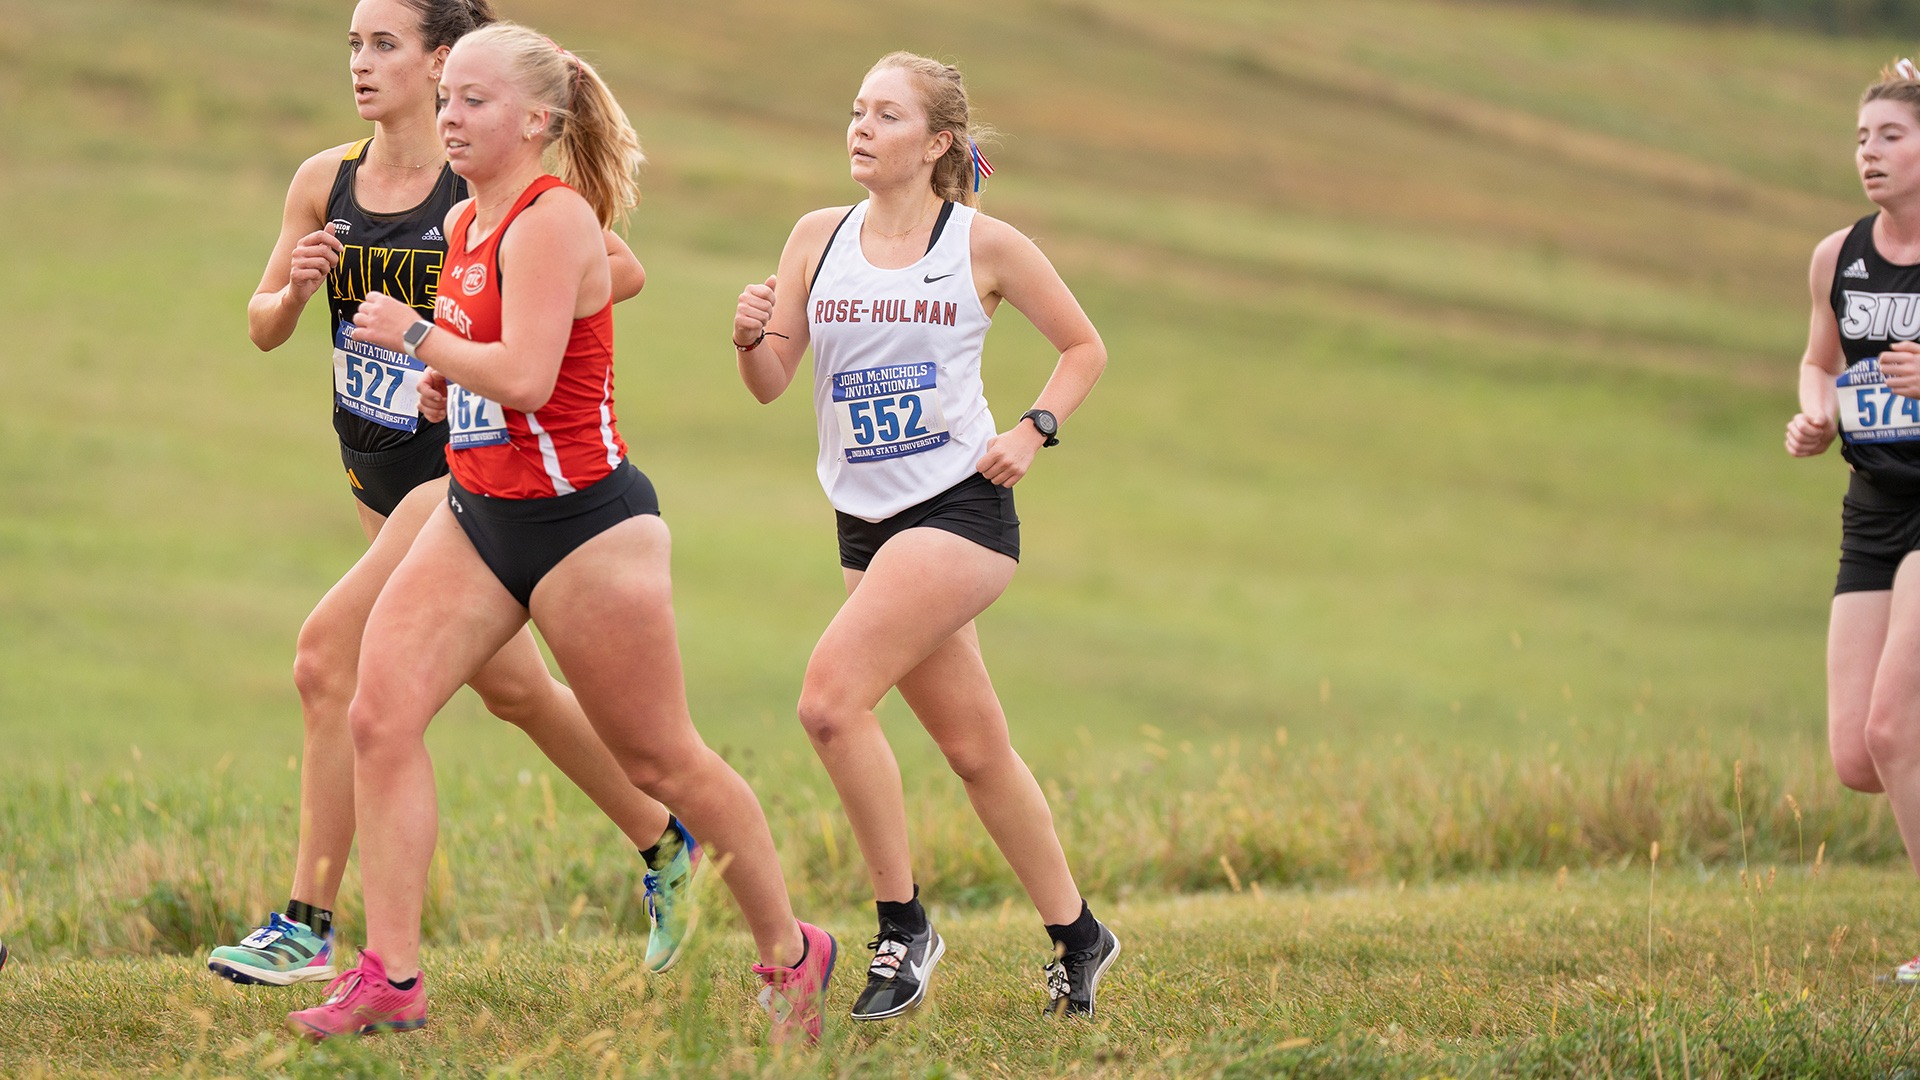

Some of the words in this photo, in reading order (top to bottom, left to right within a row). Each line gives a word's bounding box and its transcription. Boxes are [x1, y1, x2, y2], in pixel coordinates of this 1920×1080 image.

[815, 299, 957, 327] ROSE-HULMAN
[1841, 290, 1920, 341] SIU
[344, 338, 410, 366] INVITATIONAL
[346, 354, 405, 409] 527
[839, 372, 863, 387] JOHN
[845, 378, 921, 398] INVITATIONAL
[360, 404, 375, 417] STATE
[375, 411, 410, 426] UNIVERSITY
[848, 394, 928, 446] 552
[1856, 388, 1920, 428] 574
[851, 447, 875, 458] INDIANA
[876, 446, 898, 455] STATE
[900, 435, 941, 451] UNIVERSITY
[1876, 429, 1896, 439] STATE
